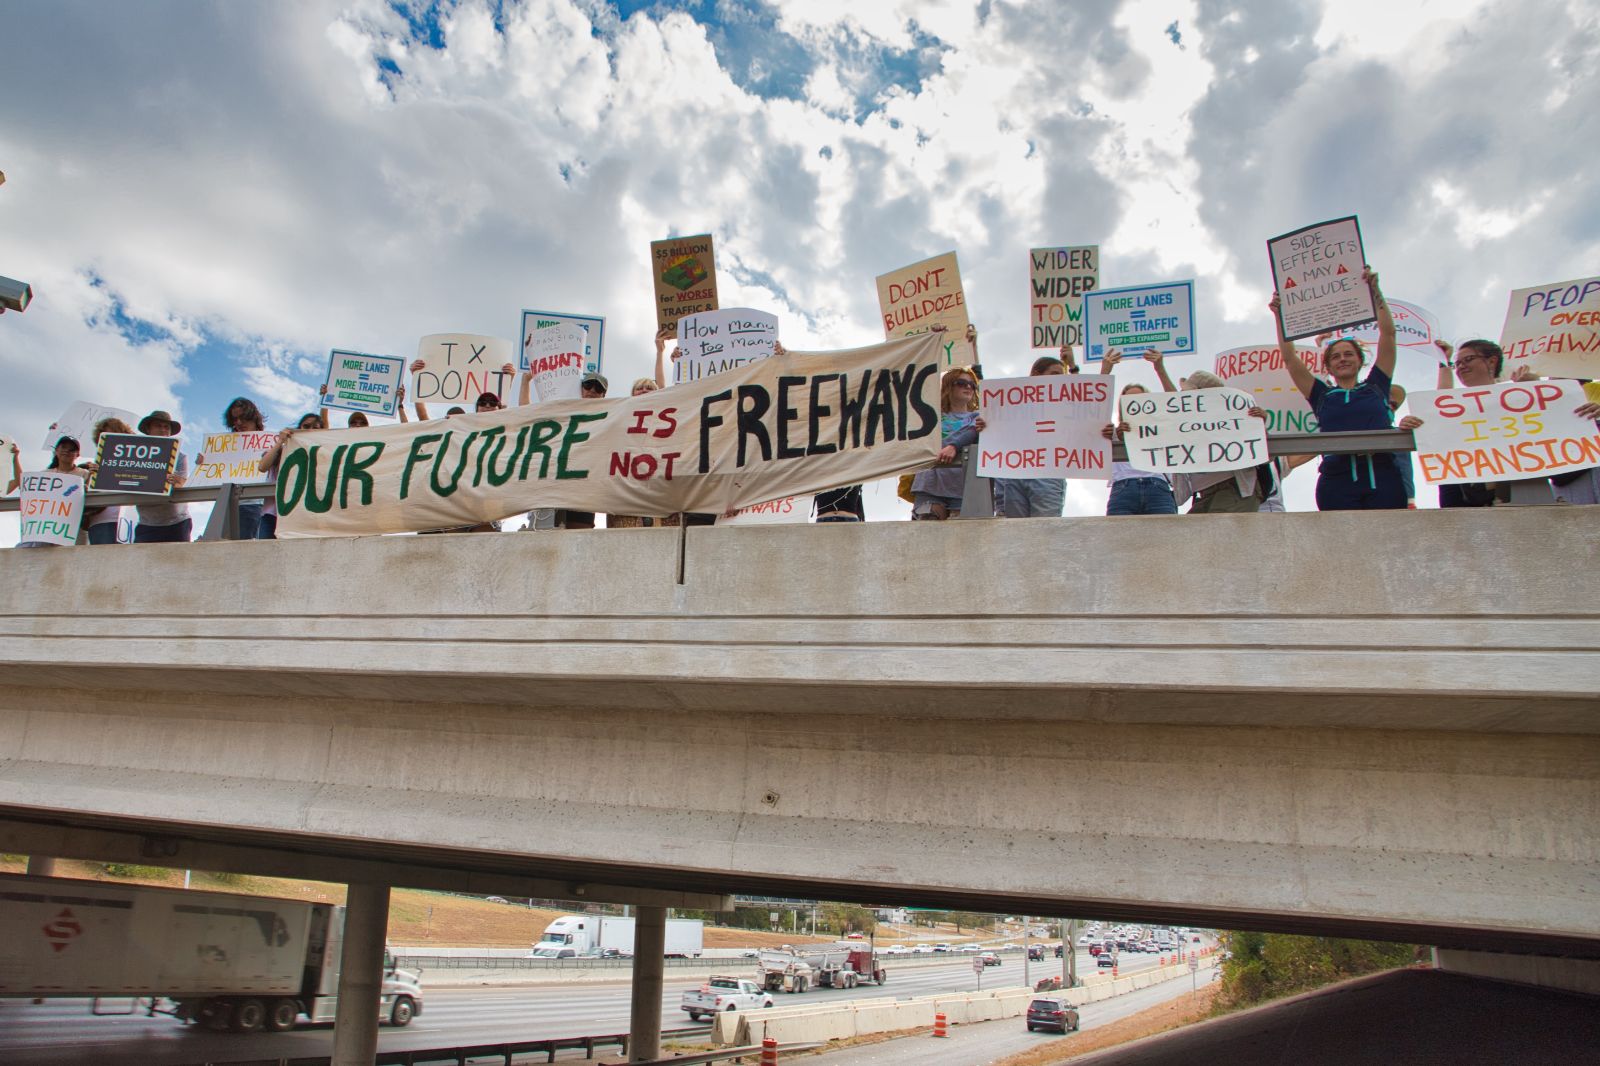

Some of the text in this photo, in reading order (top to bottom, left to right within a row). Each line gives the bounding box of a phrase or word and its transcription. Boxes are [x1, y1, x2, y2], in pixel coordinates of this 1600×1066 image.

[1290, 231, 1326, 251] SIDE
[656, 244, 708, 259] $5 BILLION
[1031, 249, 1098, 272] WIDER,
[1280, 240, 1358, 272] EFFECTS
[1303, 264, 1332, 282] MAY
[660, 288, 714, 303] for WORSE
[888, 268, 945, 304] DON'T
[1032, 276, 1095, 298] WIDER
[662, 304, 703, 316] TRAFFIC
[884, 291, 964, 332] BULLDOZE
[1103, 293, 1173, 311] MORE LANES
[684, 318, 718, 339] How
[1100, 317, 1179, 335] MORE TRAFFIC
[1550, 311, 1600, 326] OVER
[1341, 323, 1427, 339] EXPSION
[679, 348, 690, 357] is
[700, 341, 724, 357] too
[342, 359, 390, 374] MORE LANES
[530, 352, 583, 376] HAUNT
[335, 379, 390, 394] MORE TRAFFIC
[983, 382, 1108, 408] MORE LANES
[1166, 394, 1257, 414] SEE YOU
[1434, 384, 1563, 418] STOP
[627, 407, 678, 438] IS
[699, 363, 939, 474] FREEWAYS
[1139, 418, 1244, 438] IN COURT
[1462, 413, 1544, 442] I-35
[113, 444, 161, 459] STOP
[205, 433, 280, 454] MORE TAXES
[1140, 439, 1262, 467] TEX DOT
[119, 460, 167, 470] EXPANSION
[276, 412, 608, 517] OUR FUTURE
[609, 451, 681, 480] NOT
[981, 447, 1105, 470] MORE PAIN
[1420, 435, 1600, 482] EXPANSION
[195, 463, 226, 479] FOR
[22, 476, 63, 492] KEEP
